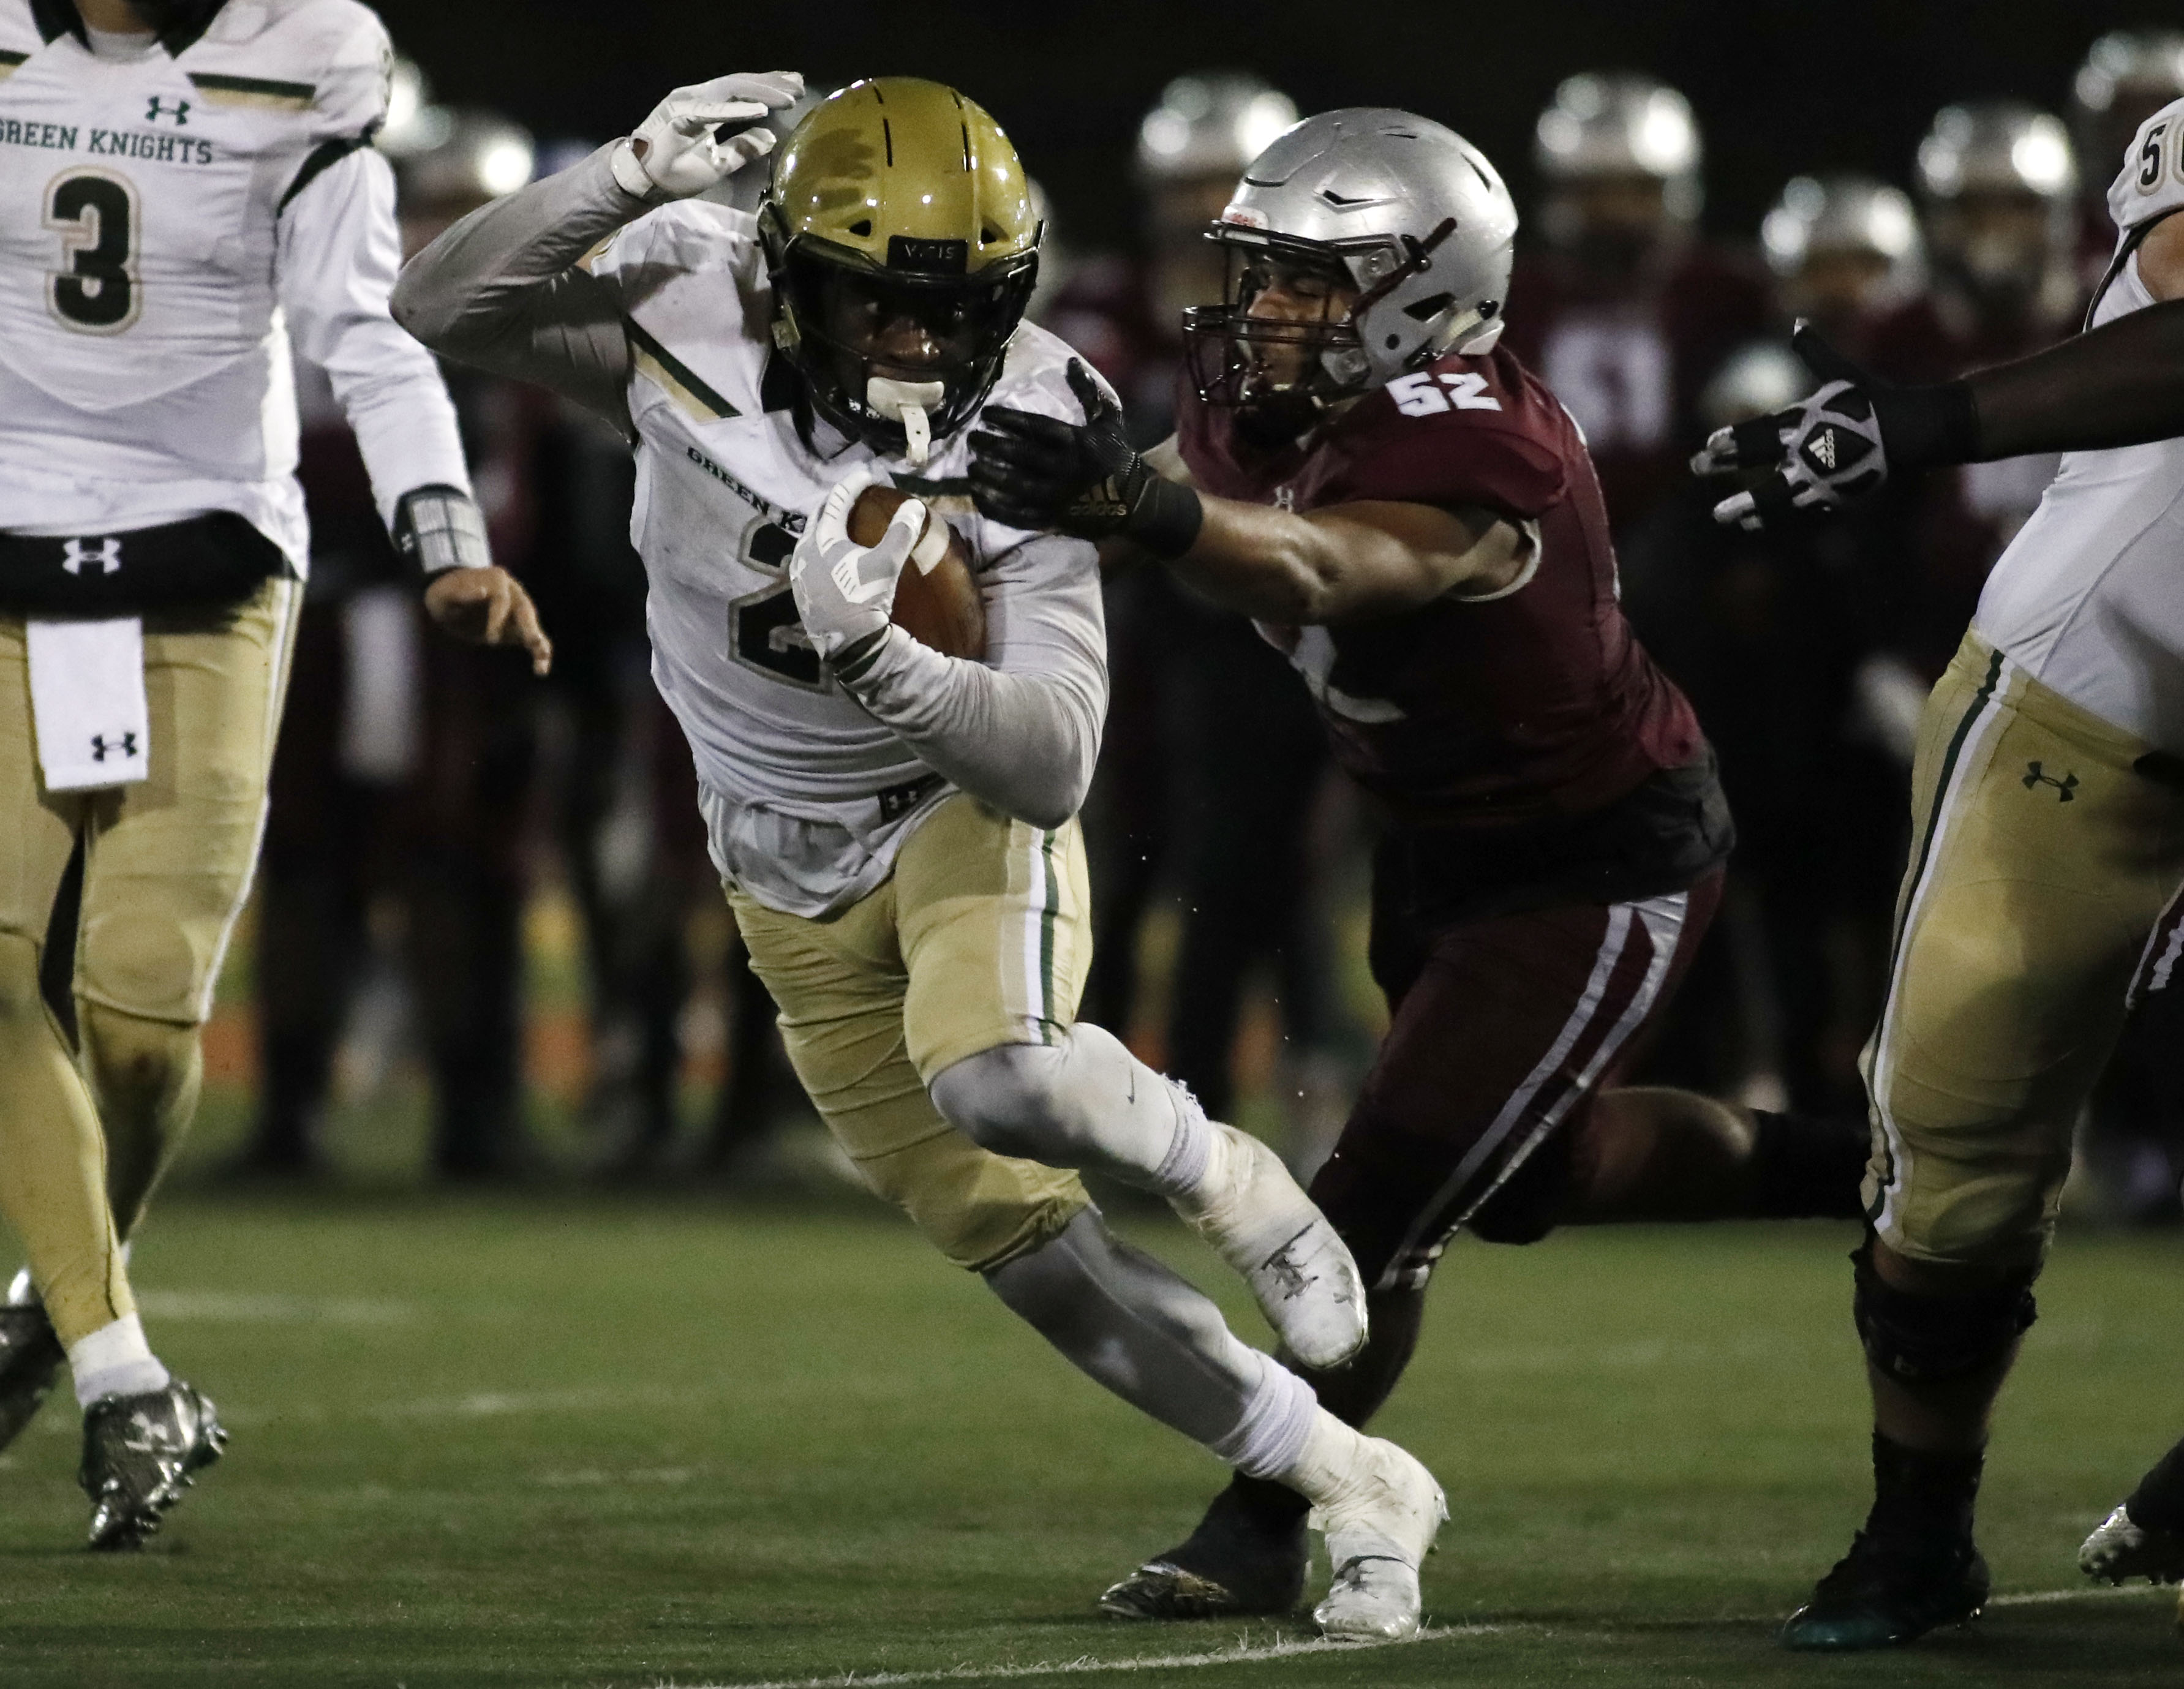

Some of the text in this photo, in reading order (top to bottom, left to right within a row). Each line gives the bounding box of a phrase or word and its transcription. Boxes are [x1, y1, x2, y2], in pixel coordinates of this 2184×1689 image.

[88, 127, 213, 164] KNIGHTS
[41, 164, 144, 336] 3
[905, 244, 955, 258] VIS
[1385, 371, 1502, 418] 52
[687, 446, 770, 515] GREEN
[728, 516, 833, 696] 2
